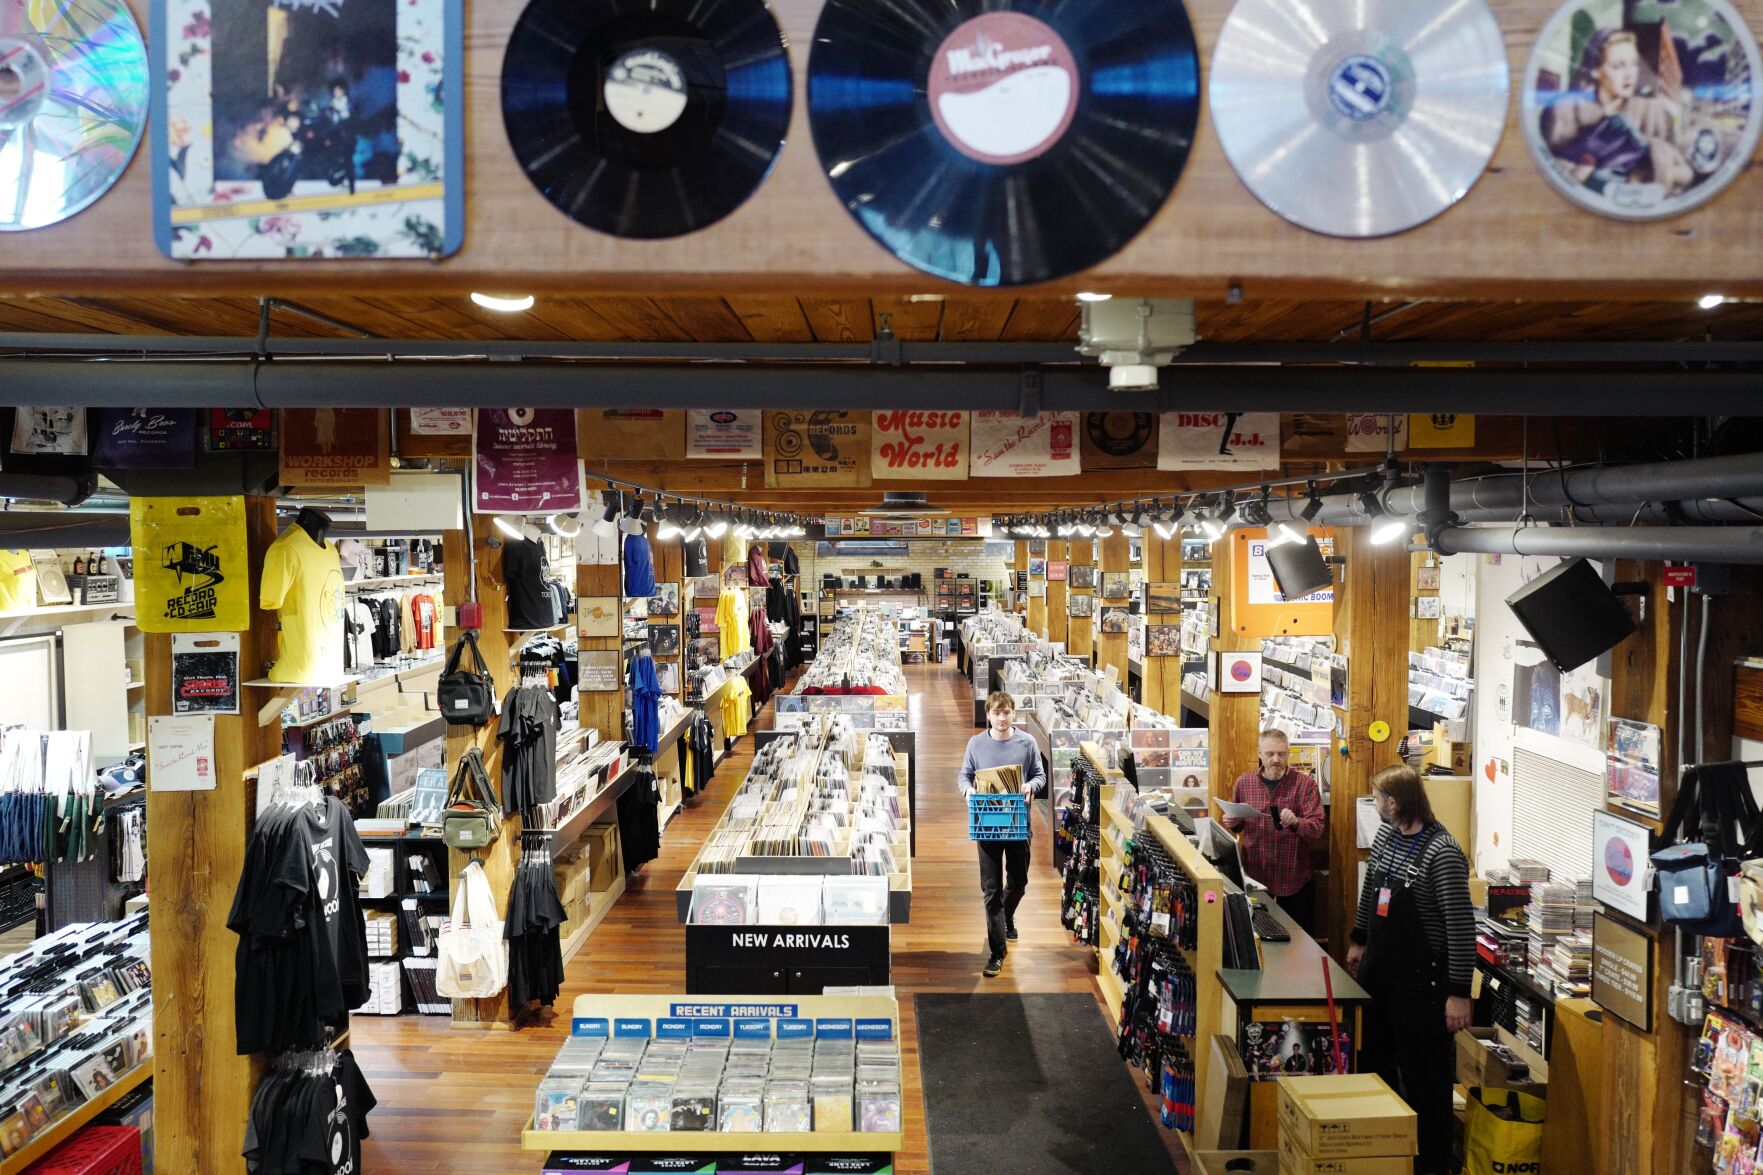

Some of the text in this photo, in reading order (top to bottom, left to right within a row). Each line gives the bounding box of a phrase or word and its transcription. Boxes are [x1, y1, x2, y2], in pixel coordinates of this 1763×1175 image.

[877, 410, 961, 434] Music
[1178, 413, 1224, 428] DISC
[808, 424, 857, 435] RECORDS
[286, 455, 374, 467] WORKSHOP
[880, 442, 960, 468] World
[304, 468, 359, 478] records
[168, 588, 215, 609] RECORD
[1310, 593, 1334, 601] BOOM
[732, 933, 850, 949] NEW ARRIVALS
[676, 1006, 792, 1017] RECENT ARRIVALS
